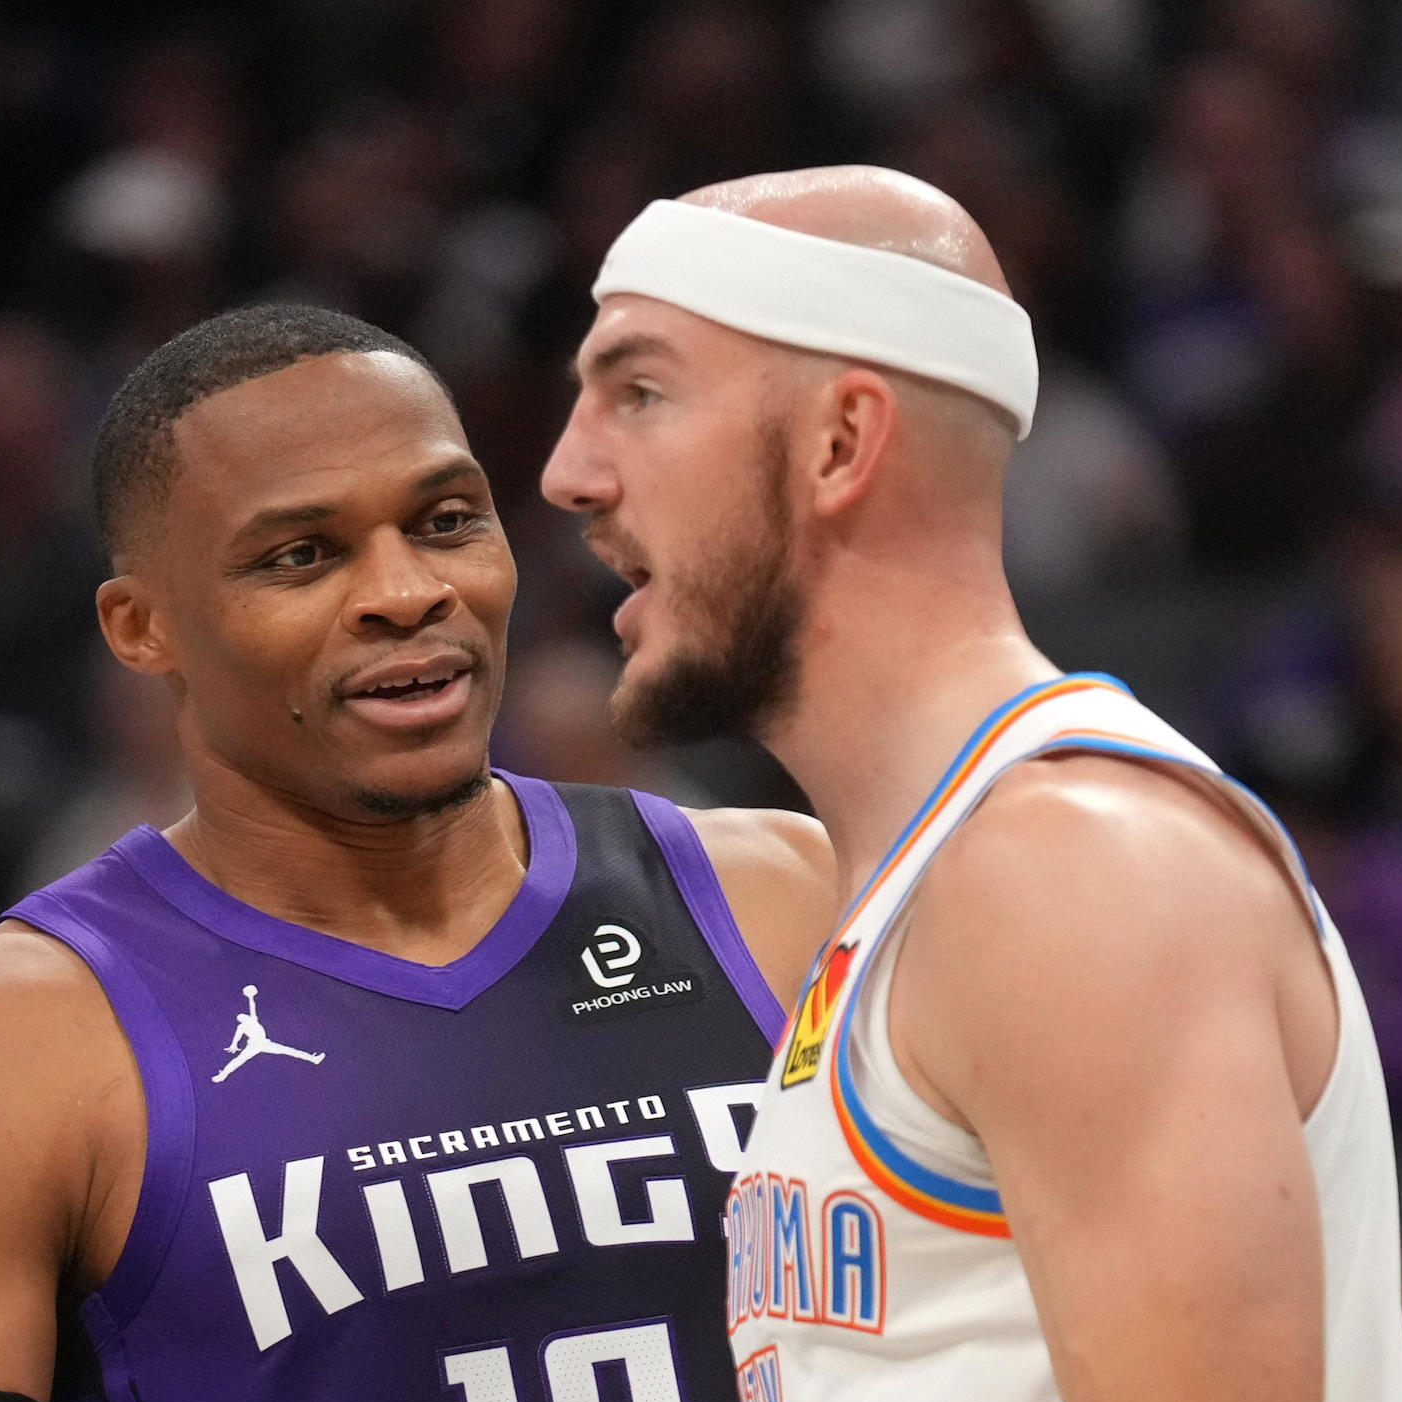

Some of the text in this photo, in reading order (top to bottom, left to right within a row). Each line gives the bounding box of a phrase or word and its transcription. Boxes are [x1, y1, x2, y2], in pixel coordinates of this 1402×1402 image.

[572, 979, 692, 1015] PHOONG LAW
[347, 1095, 667, 1171] SACRAMENTO
